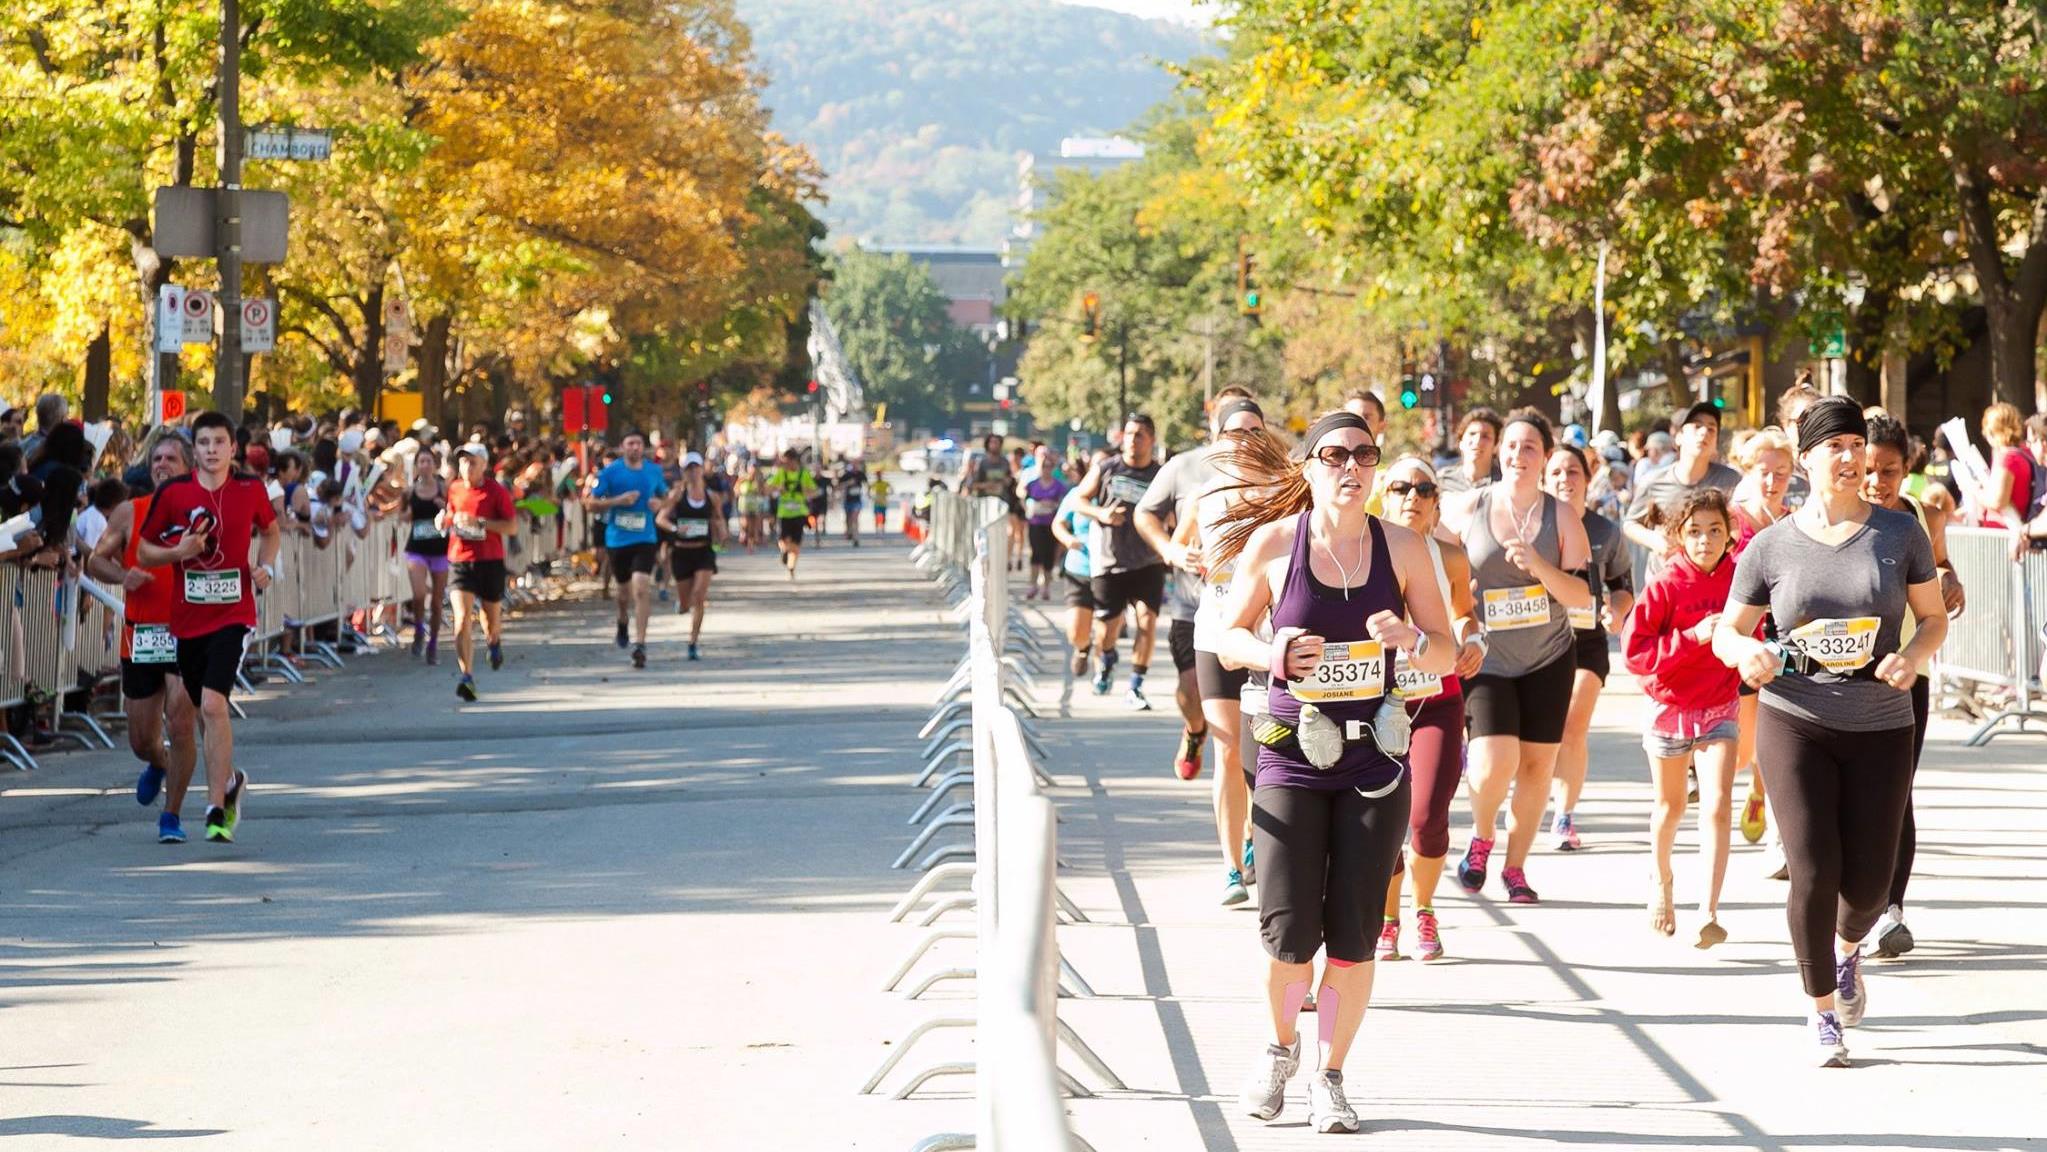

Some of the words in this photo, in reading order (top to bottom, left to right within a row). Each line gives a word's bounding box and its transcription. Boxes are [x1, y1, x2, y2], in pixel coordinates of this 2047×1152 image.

[1487, 597, 1548, 617] 8-38458
[1797, 631, 1871, 656] 3-33241
[1294, 659, 1382, 684] -35374
[1322, 690, 1355, 699] JOSIANE
